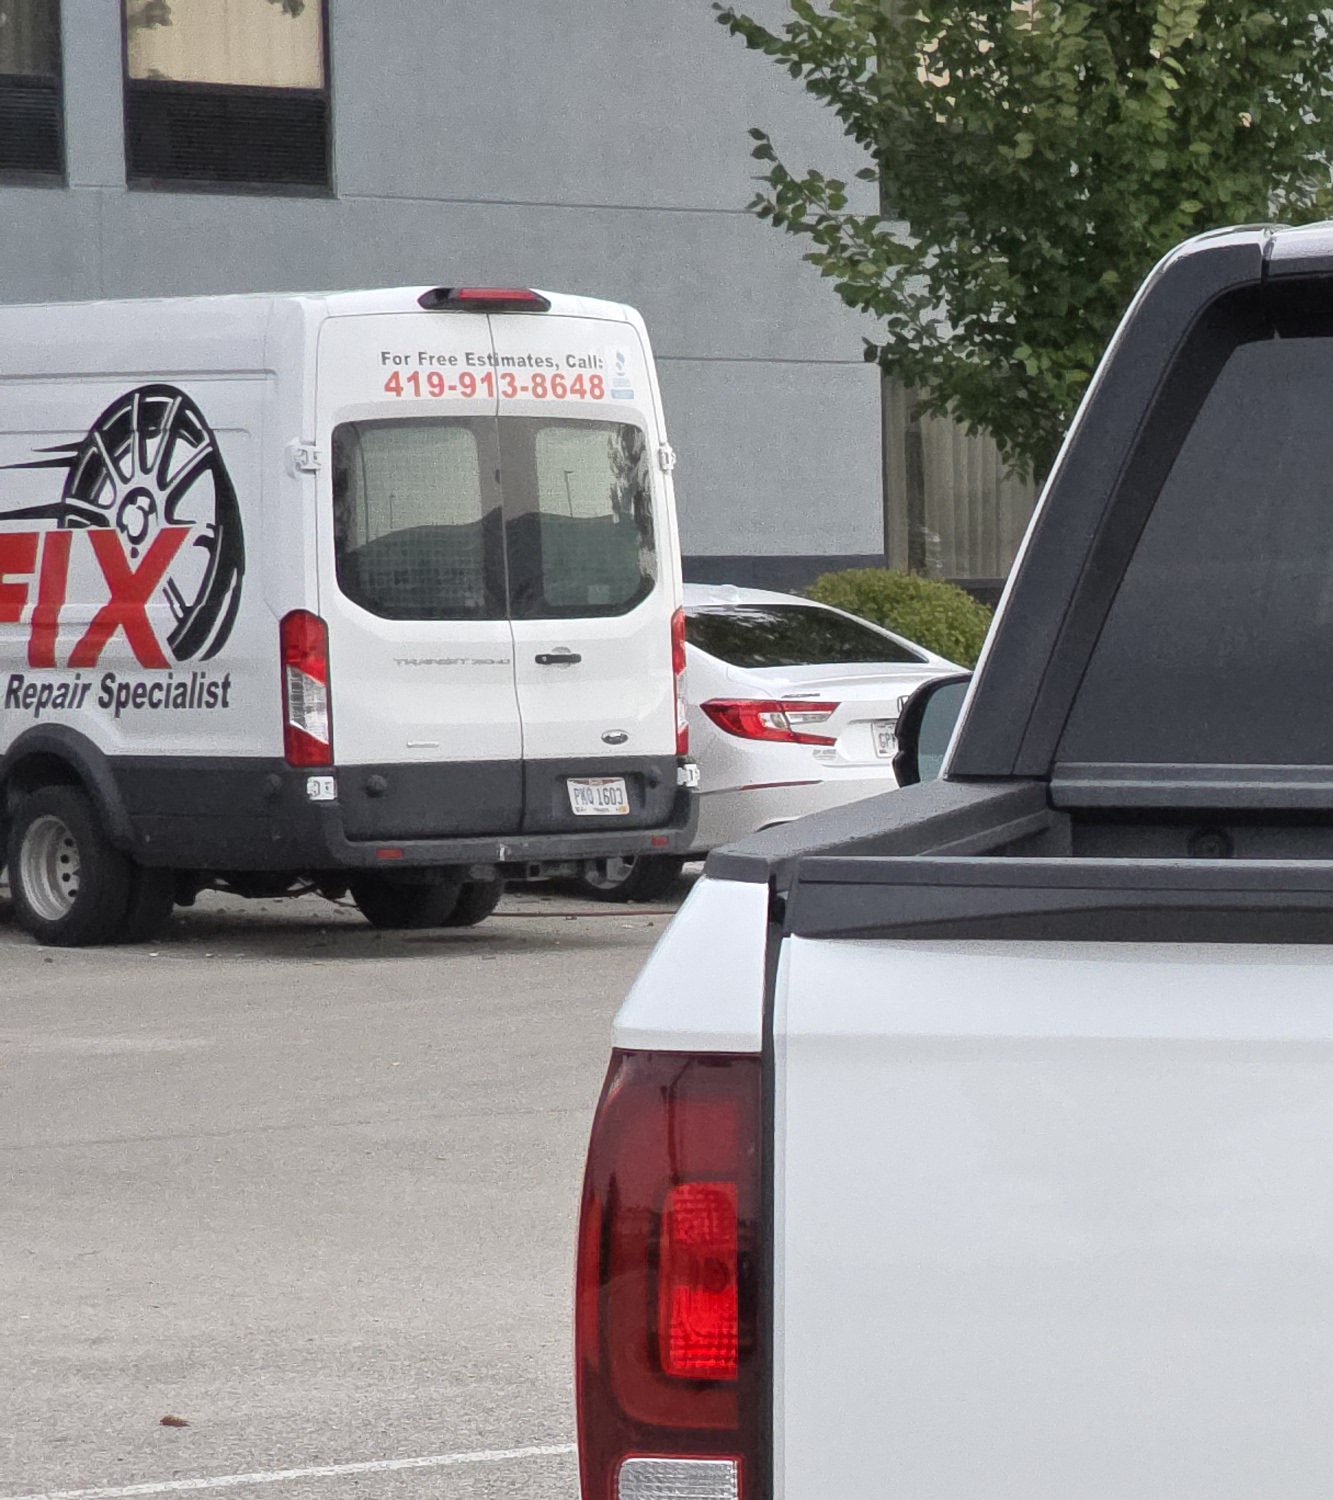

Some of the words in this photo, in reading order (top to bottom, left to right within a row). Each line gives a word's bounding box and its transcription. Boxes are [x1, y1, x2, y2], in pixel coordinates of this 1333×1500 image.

[380, 351, 410, 366] For
[418, 351, 458, 366] Free
[465, 351, 560, 370] Estimates,
[565, 354, 604, 369] Call:
[384, 370, 605, 400] 419-913-8648
[4, 673, 92, 719] Repair
[97, 671, 231, 719] Specialist
